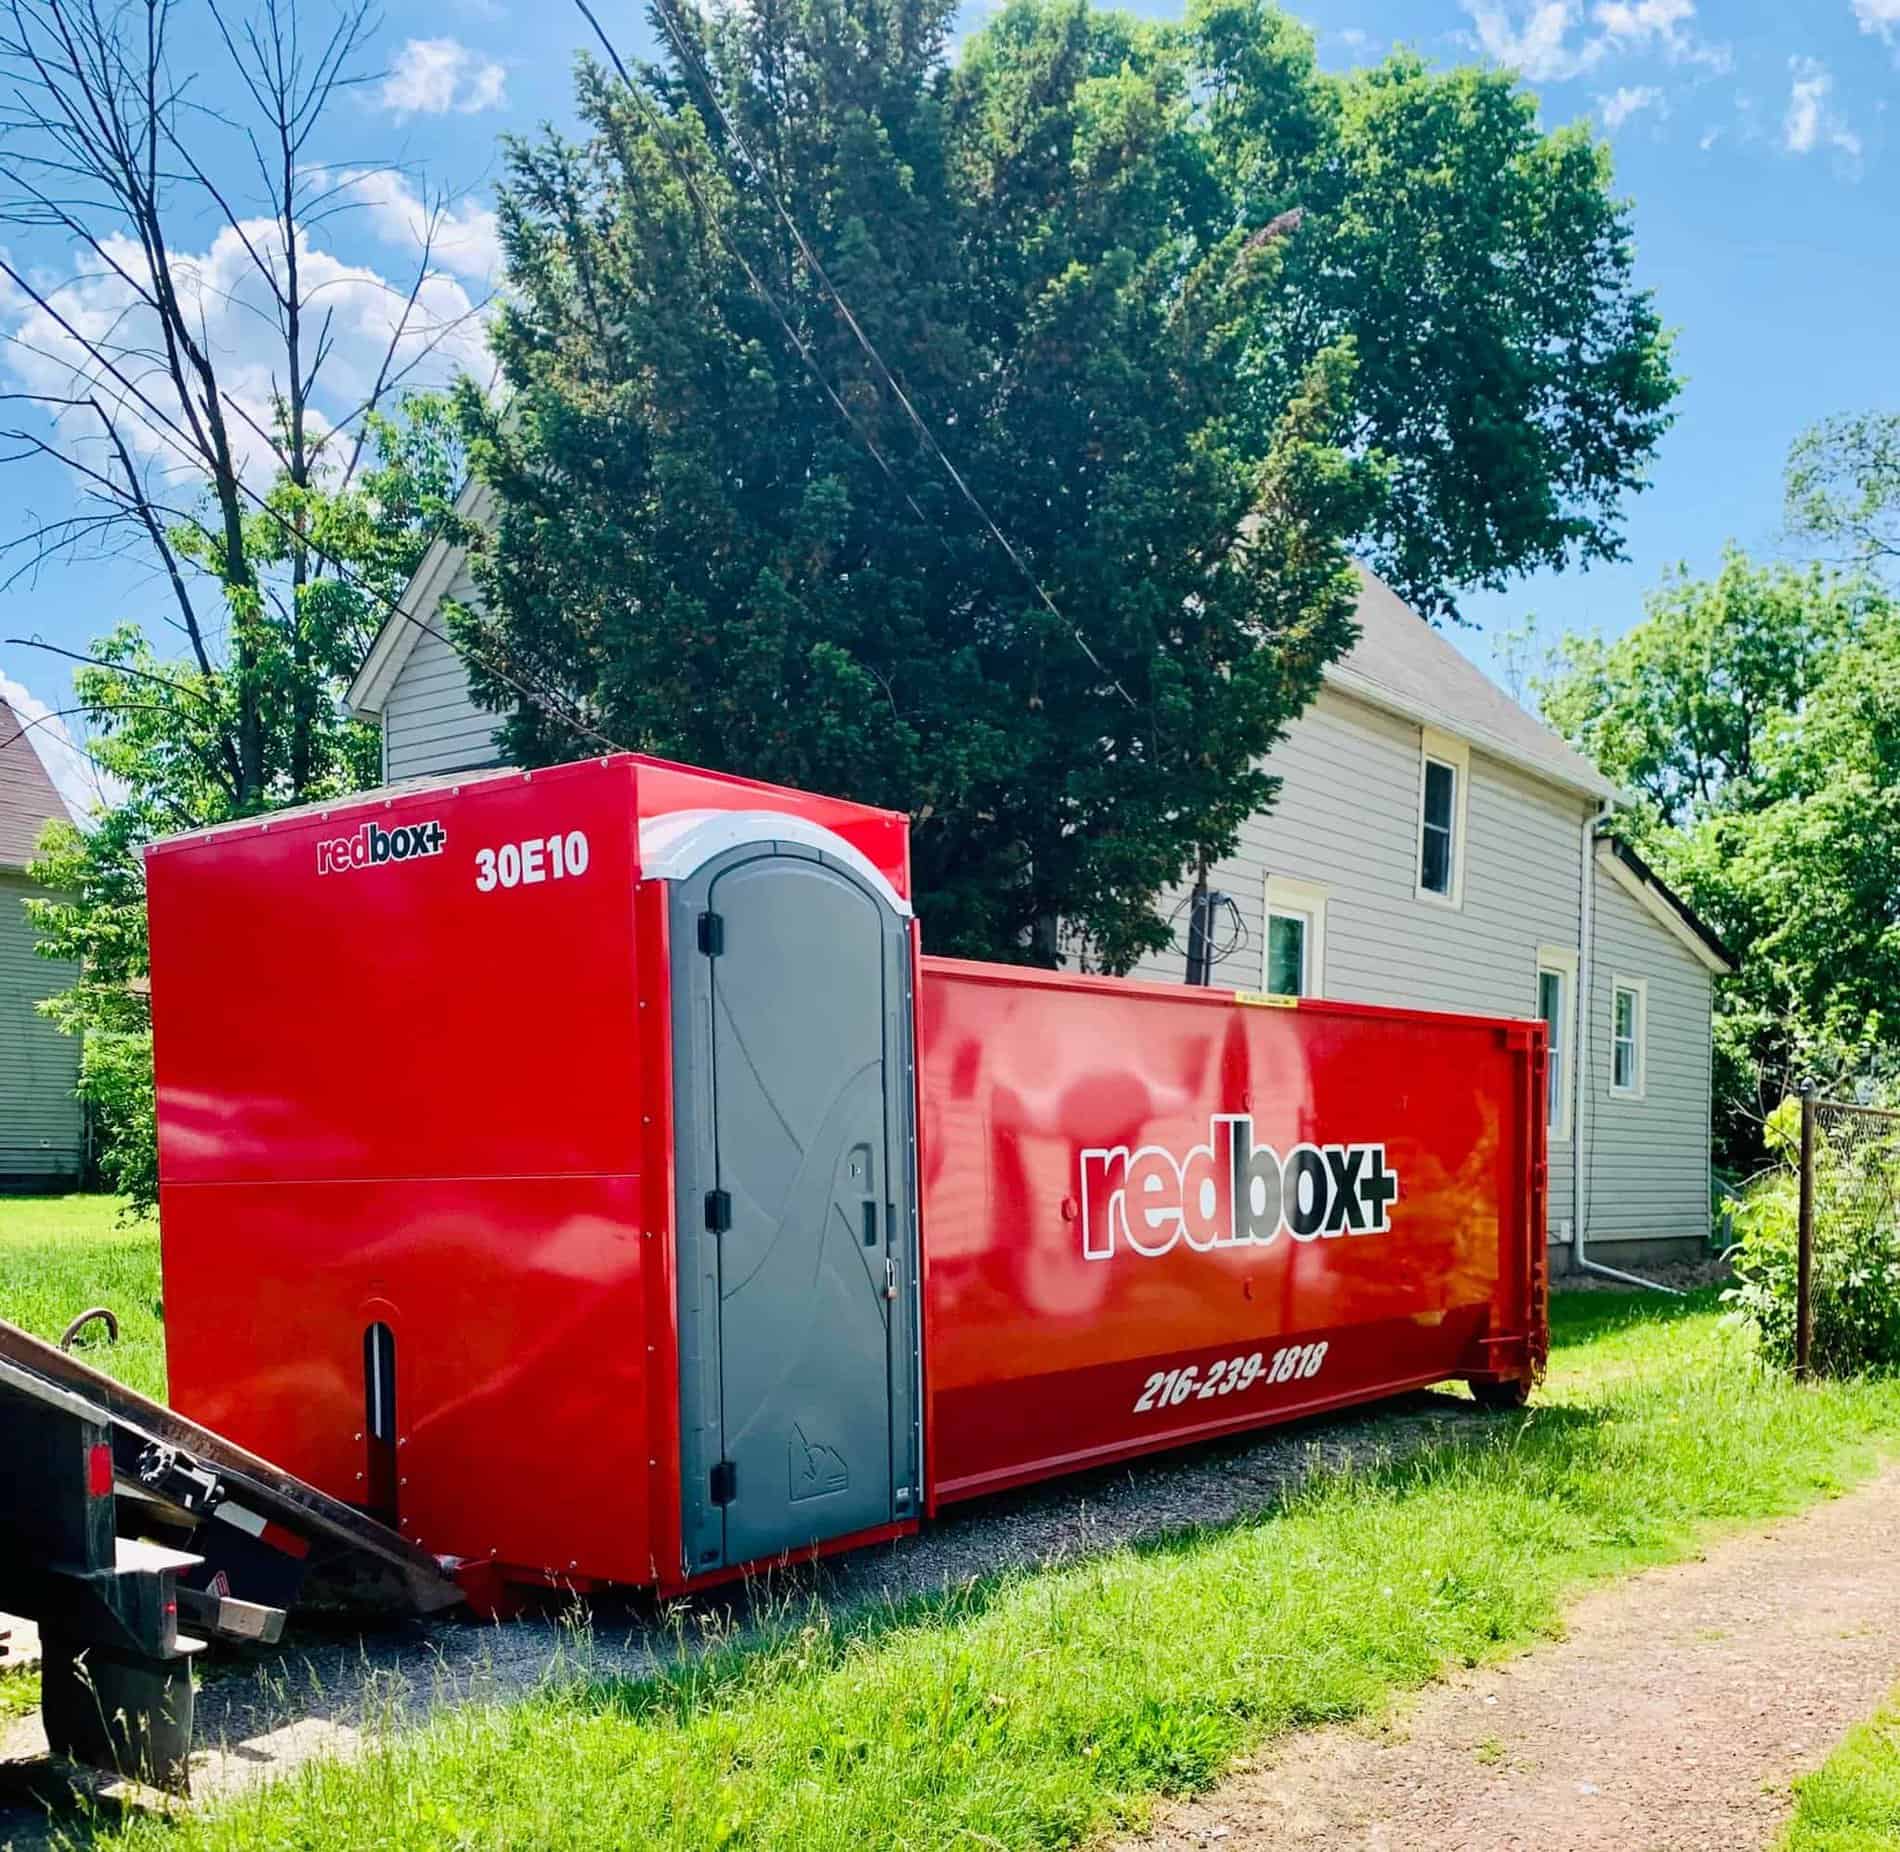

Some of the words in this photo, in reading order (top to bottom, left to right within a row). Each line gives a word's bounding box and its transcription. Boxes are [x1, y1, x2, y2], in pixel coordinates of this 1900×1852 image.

[317, 821, 446, 874] redbox+
[475, 831, 589, 892] 30E10
[1080, 1114, 1397, 1260] redbox+
[1133, 1342, 1328, 1413] 216-239-1818
